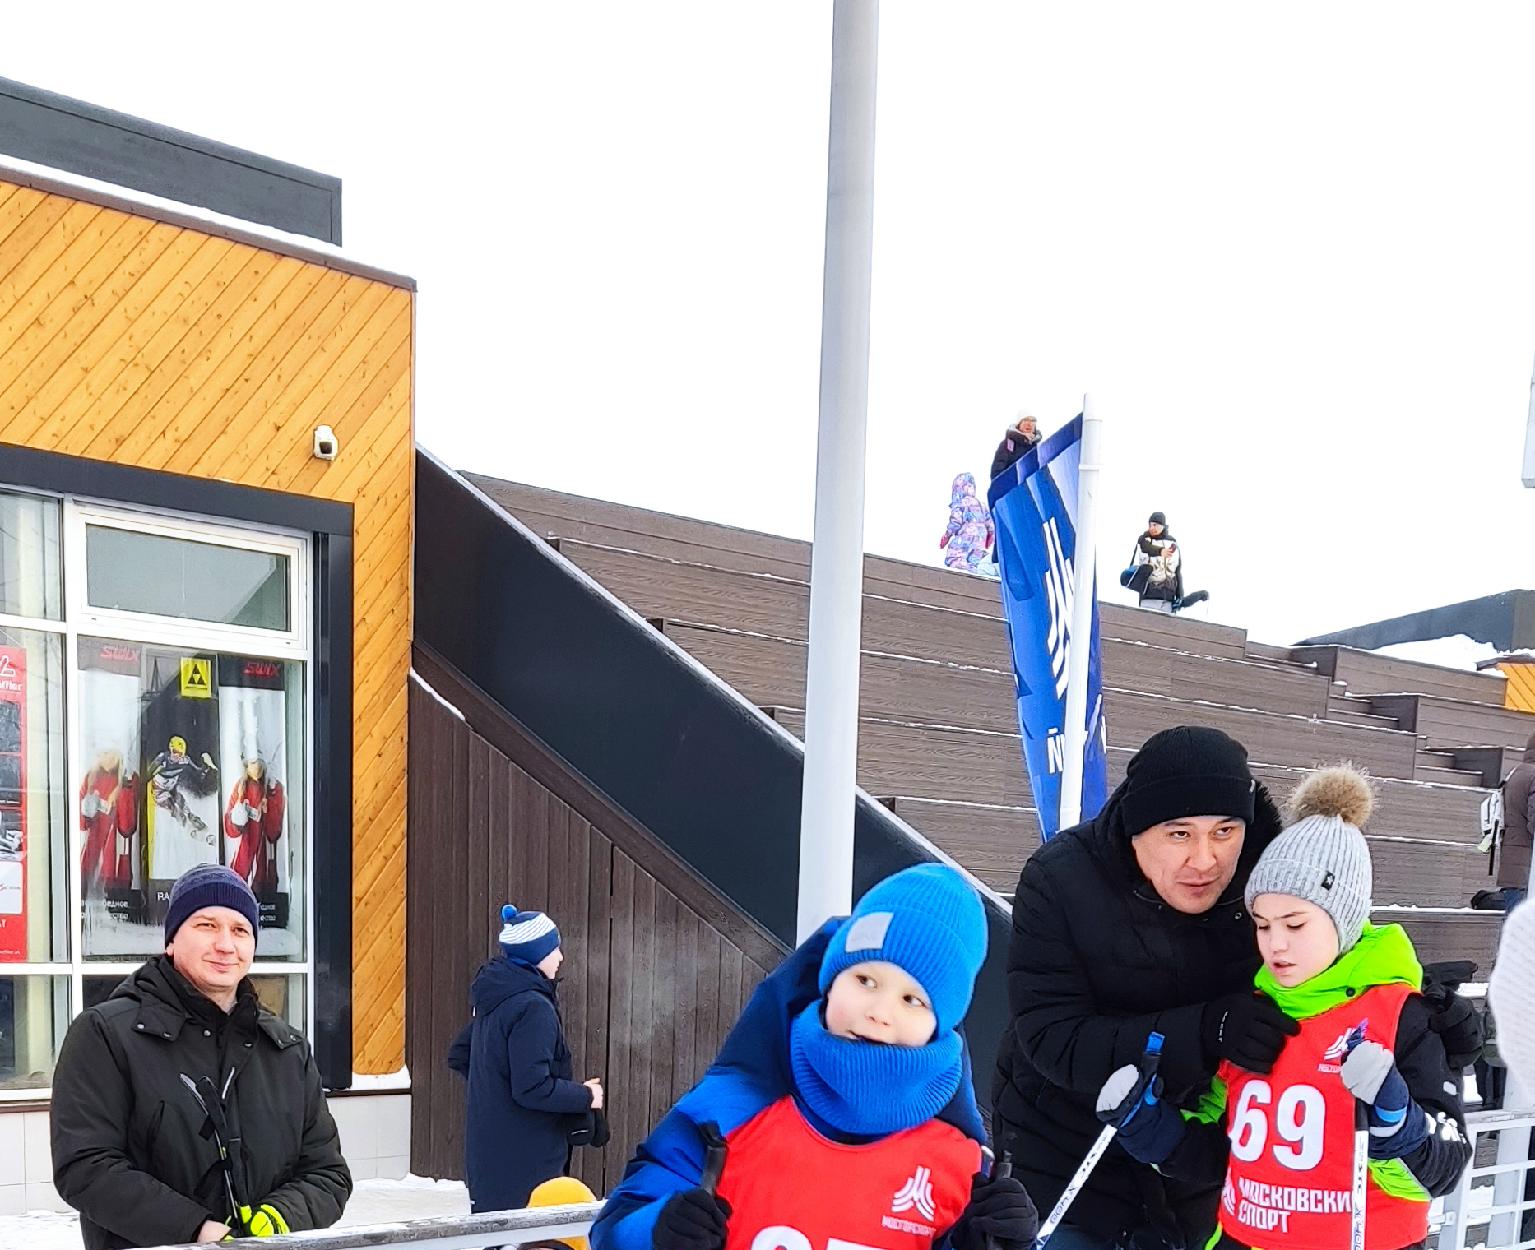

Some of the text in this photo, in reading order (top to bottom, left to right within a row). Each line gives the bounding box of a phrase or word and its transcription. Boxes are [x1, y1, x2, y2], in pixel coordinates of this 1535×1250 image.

[1228, 1080, 1326, 1170] 69
[1239, 1177, 1353, 1213] МОСКОВСКИ
[1238, 1199, 1291, 1233] СПОРТ
